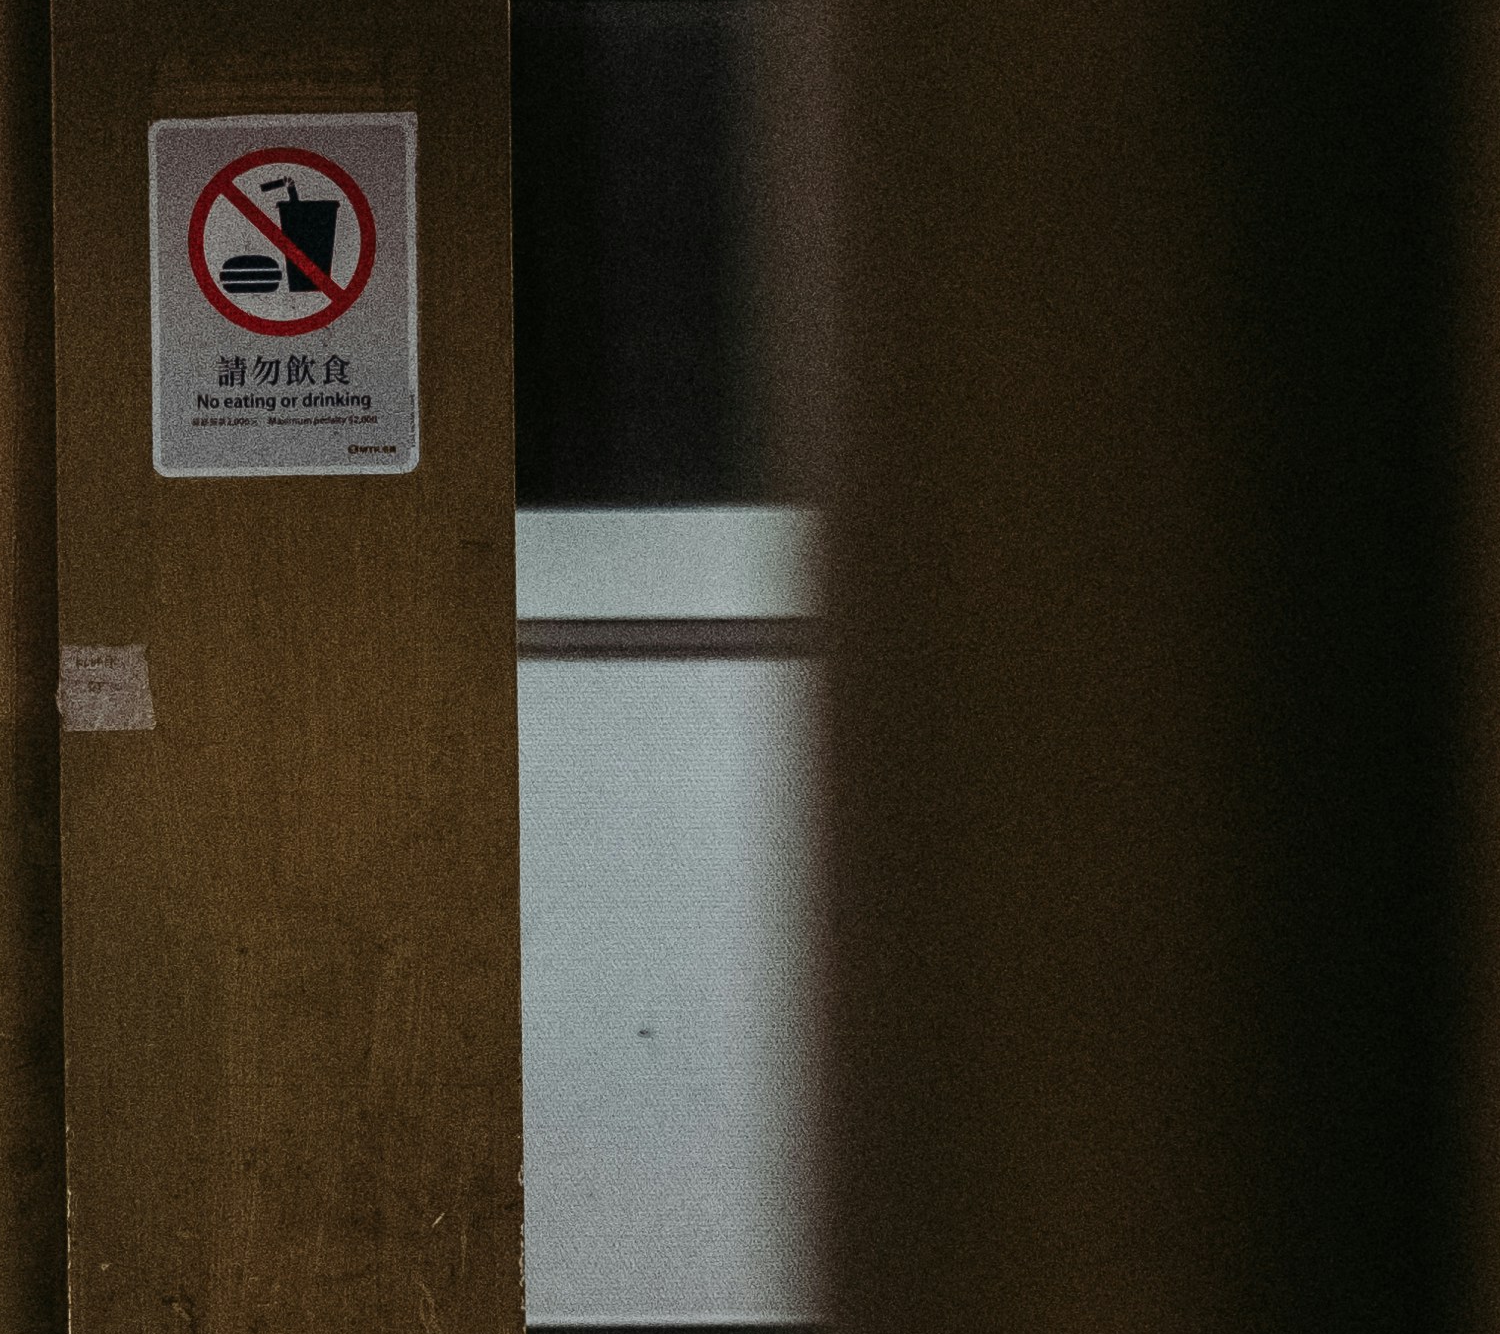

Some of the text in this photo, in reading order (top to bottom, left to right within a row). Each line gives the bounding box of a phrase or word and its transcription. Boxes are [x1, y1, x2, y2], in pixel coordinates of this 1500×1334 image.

[218, 354, 350, 387] 請勿飲食
[197, 391, 372, 411] No eating or drinking
